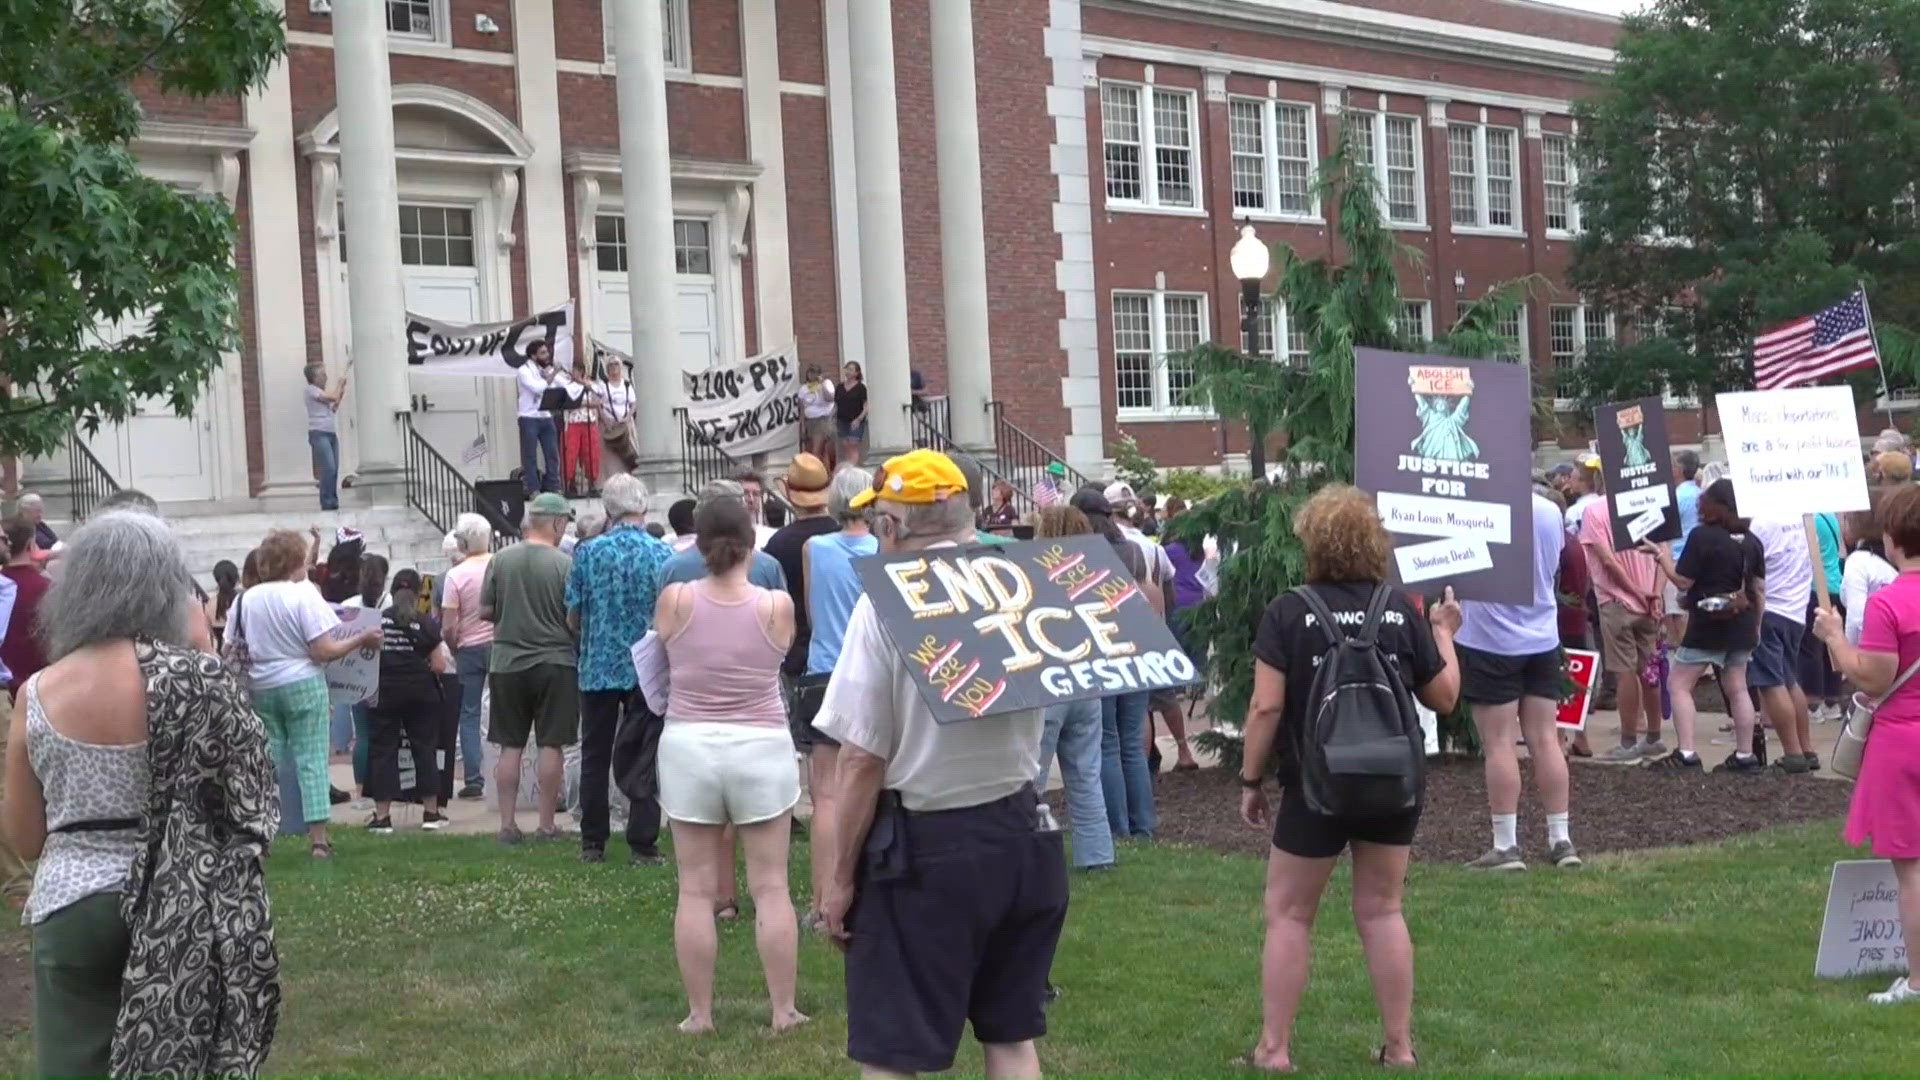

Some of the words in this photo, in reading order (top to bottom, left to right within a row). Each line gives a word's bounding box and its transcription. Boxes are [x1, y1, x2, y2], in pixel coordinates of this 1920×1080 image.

[479, 328, 508, 356] OF
[501, 311, 566, 368] CT
[689, 368, 745, 402] 1100+
[749, 355, 793, 393] PPL
[1417, 368, 1464, 381] ABOLISH
[1429, 380, 1453, 392] ICE
[764, 392, 801, 430] 2025
[1741, 440, 1760, 454] are
[1397, 455, 1490, 479] JUSTICE
[1620, 461, 1657, 480] JUSTICE
[1749, 466, 1783, 484] funded
[1785, 466, 1804, 481] with
[1807, 468, 1822, 480] our
[1421, 477, 1466, 497] FOR
[1631, 477, 1650, 489] FOR
[1391, 507, 1415, 522] Ryan
[1418, 510, 1443, 525] Louis
[1447, 512, 1495, 530] Mosqueda
[1412, 556, 1450, 571] Shooting
[1450, 547, 1476, 562] Death
[884, 556, 1033, 619] END
[973, 600, 1137, 673] ICE
[1040, 648, 1195, 698] GESTAPO
[1849, 881, 1898, 913] anger!
